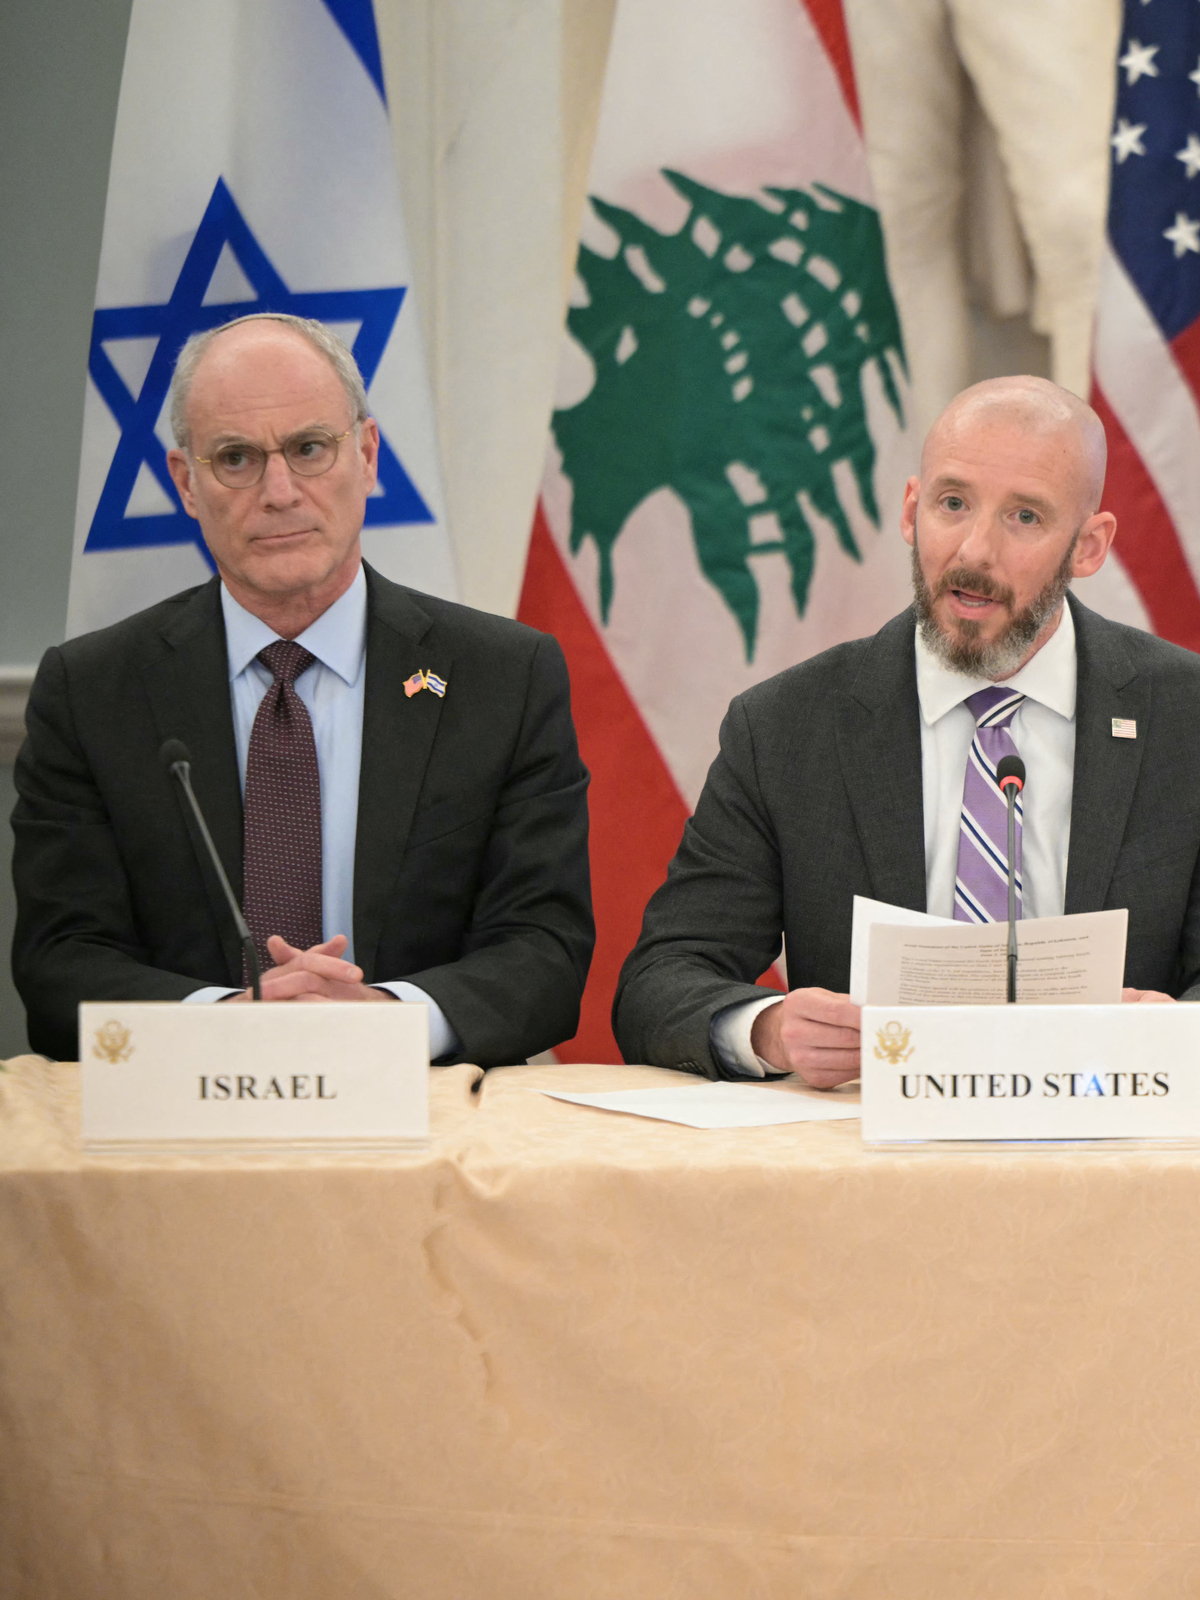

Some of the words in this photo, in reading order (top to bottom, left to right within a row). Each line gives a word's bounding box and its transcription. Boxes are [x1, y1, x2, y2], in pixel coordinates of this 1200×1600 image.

[199, 1075, 338, 1100] ISRAEL
[901, 1073, 1032, 1099] UNITED
[1043, 1072, 1170, 1097] STATES
